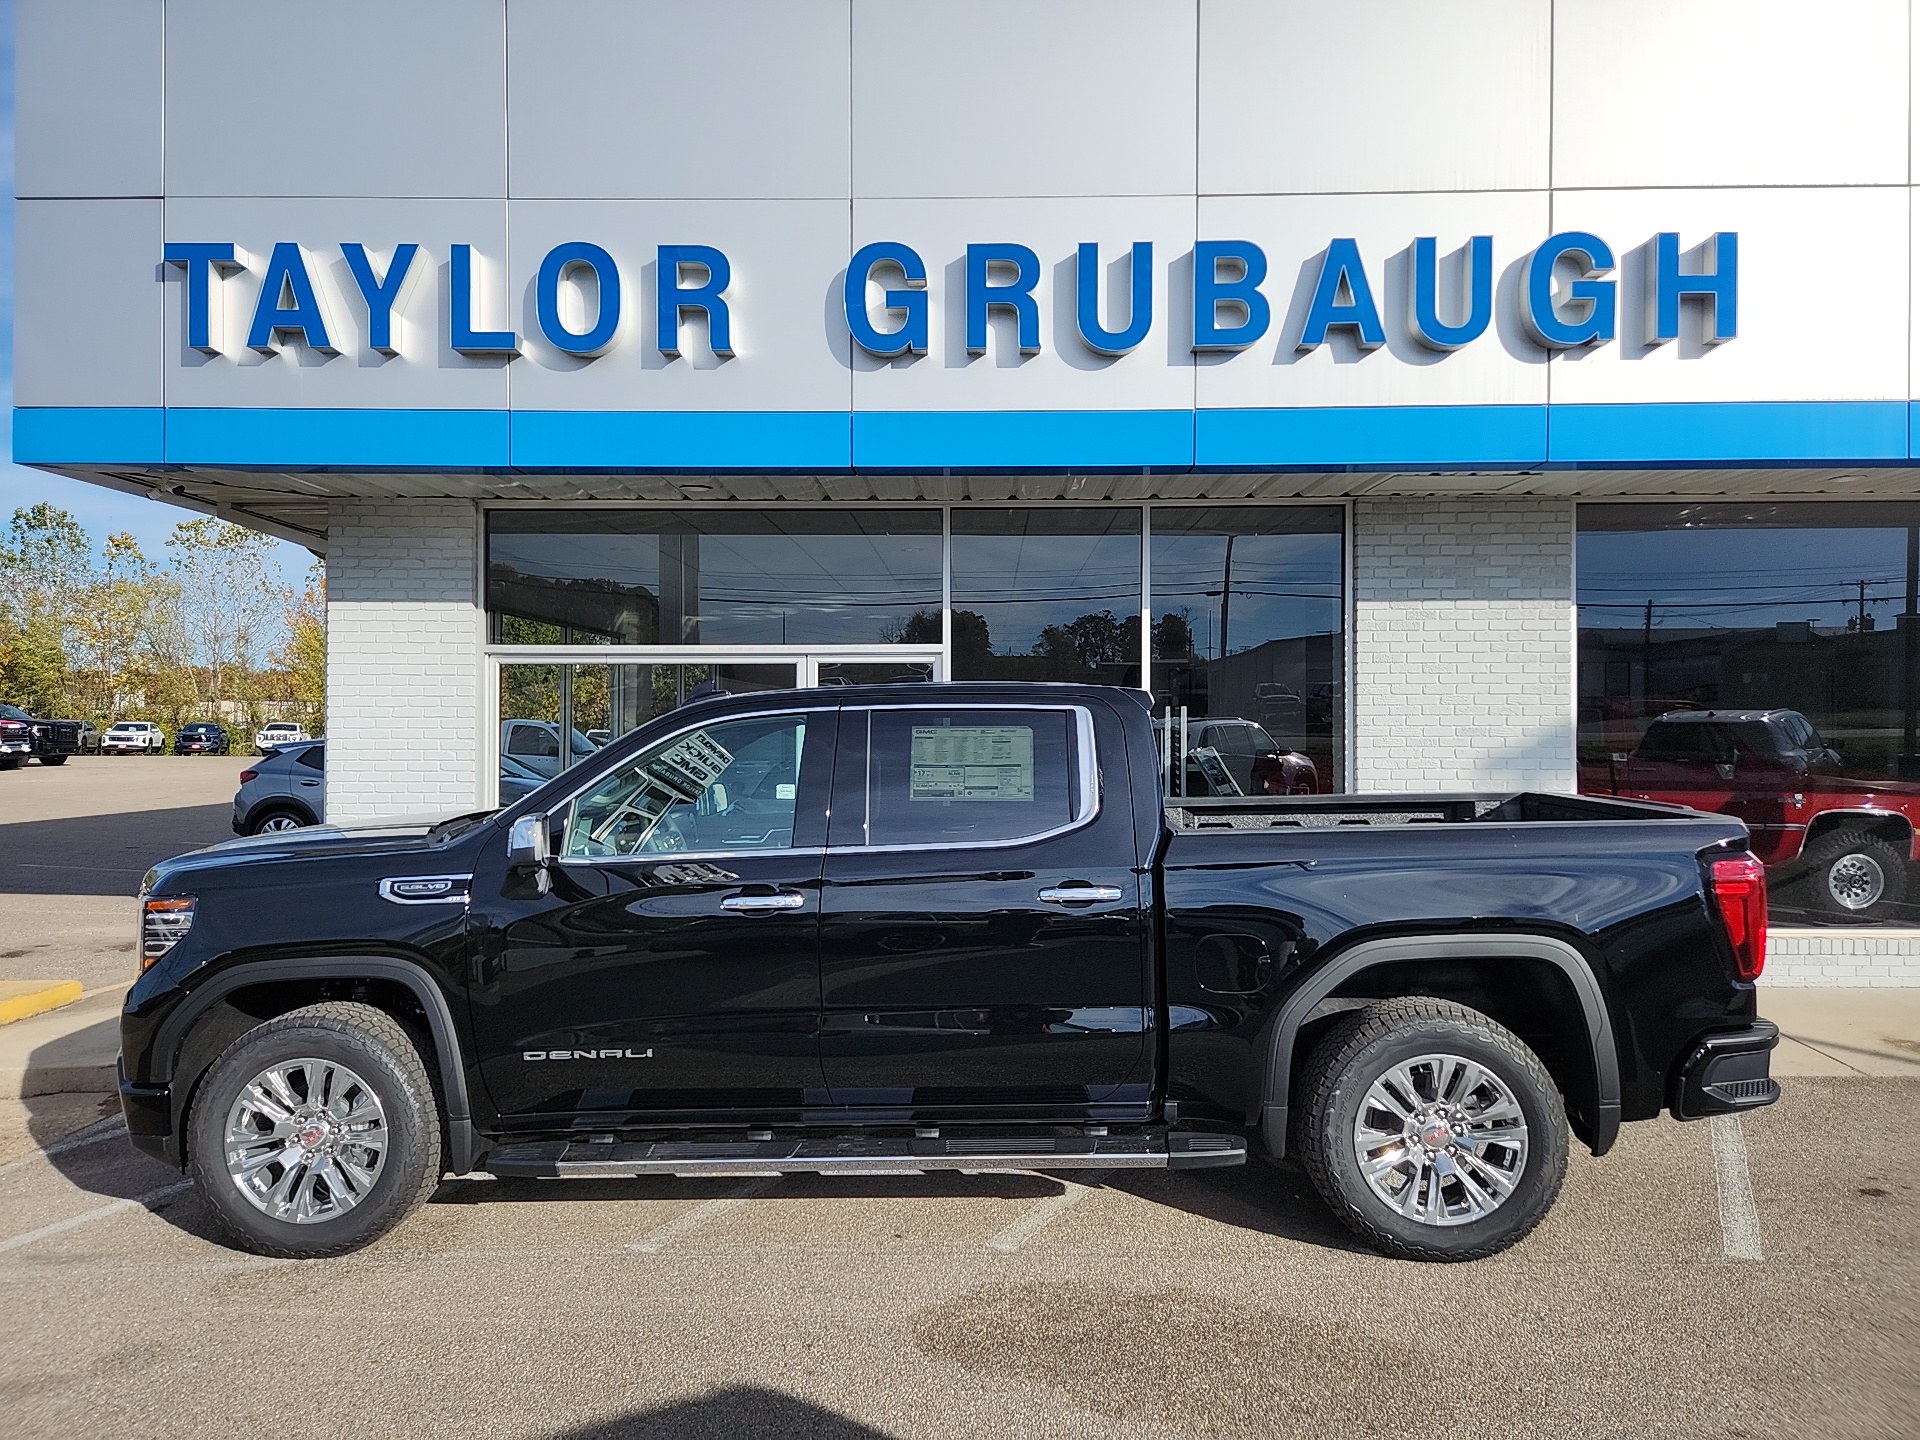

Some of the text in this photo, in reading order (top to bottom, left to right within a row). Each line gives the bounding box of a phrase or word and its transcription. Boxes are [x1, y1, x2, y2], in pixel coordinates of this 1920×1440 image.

[163, 231, 1739, 356] TAYLOR GRUBAUGH
[522, 1048, 654, 1061] DENALI
